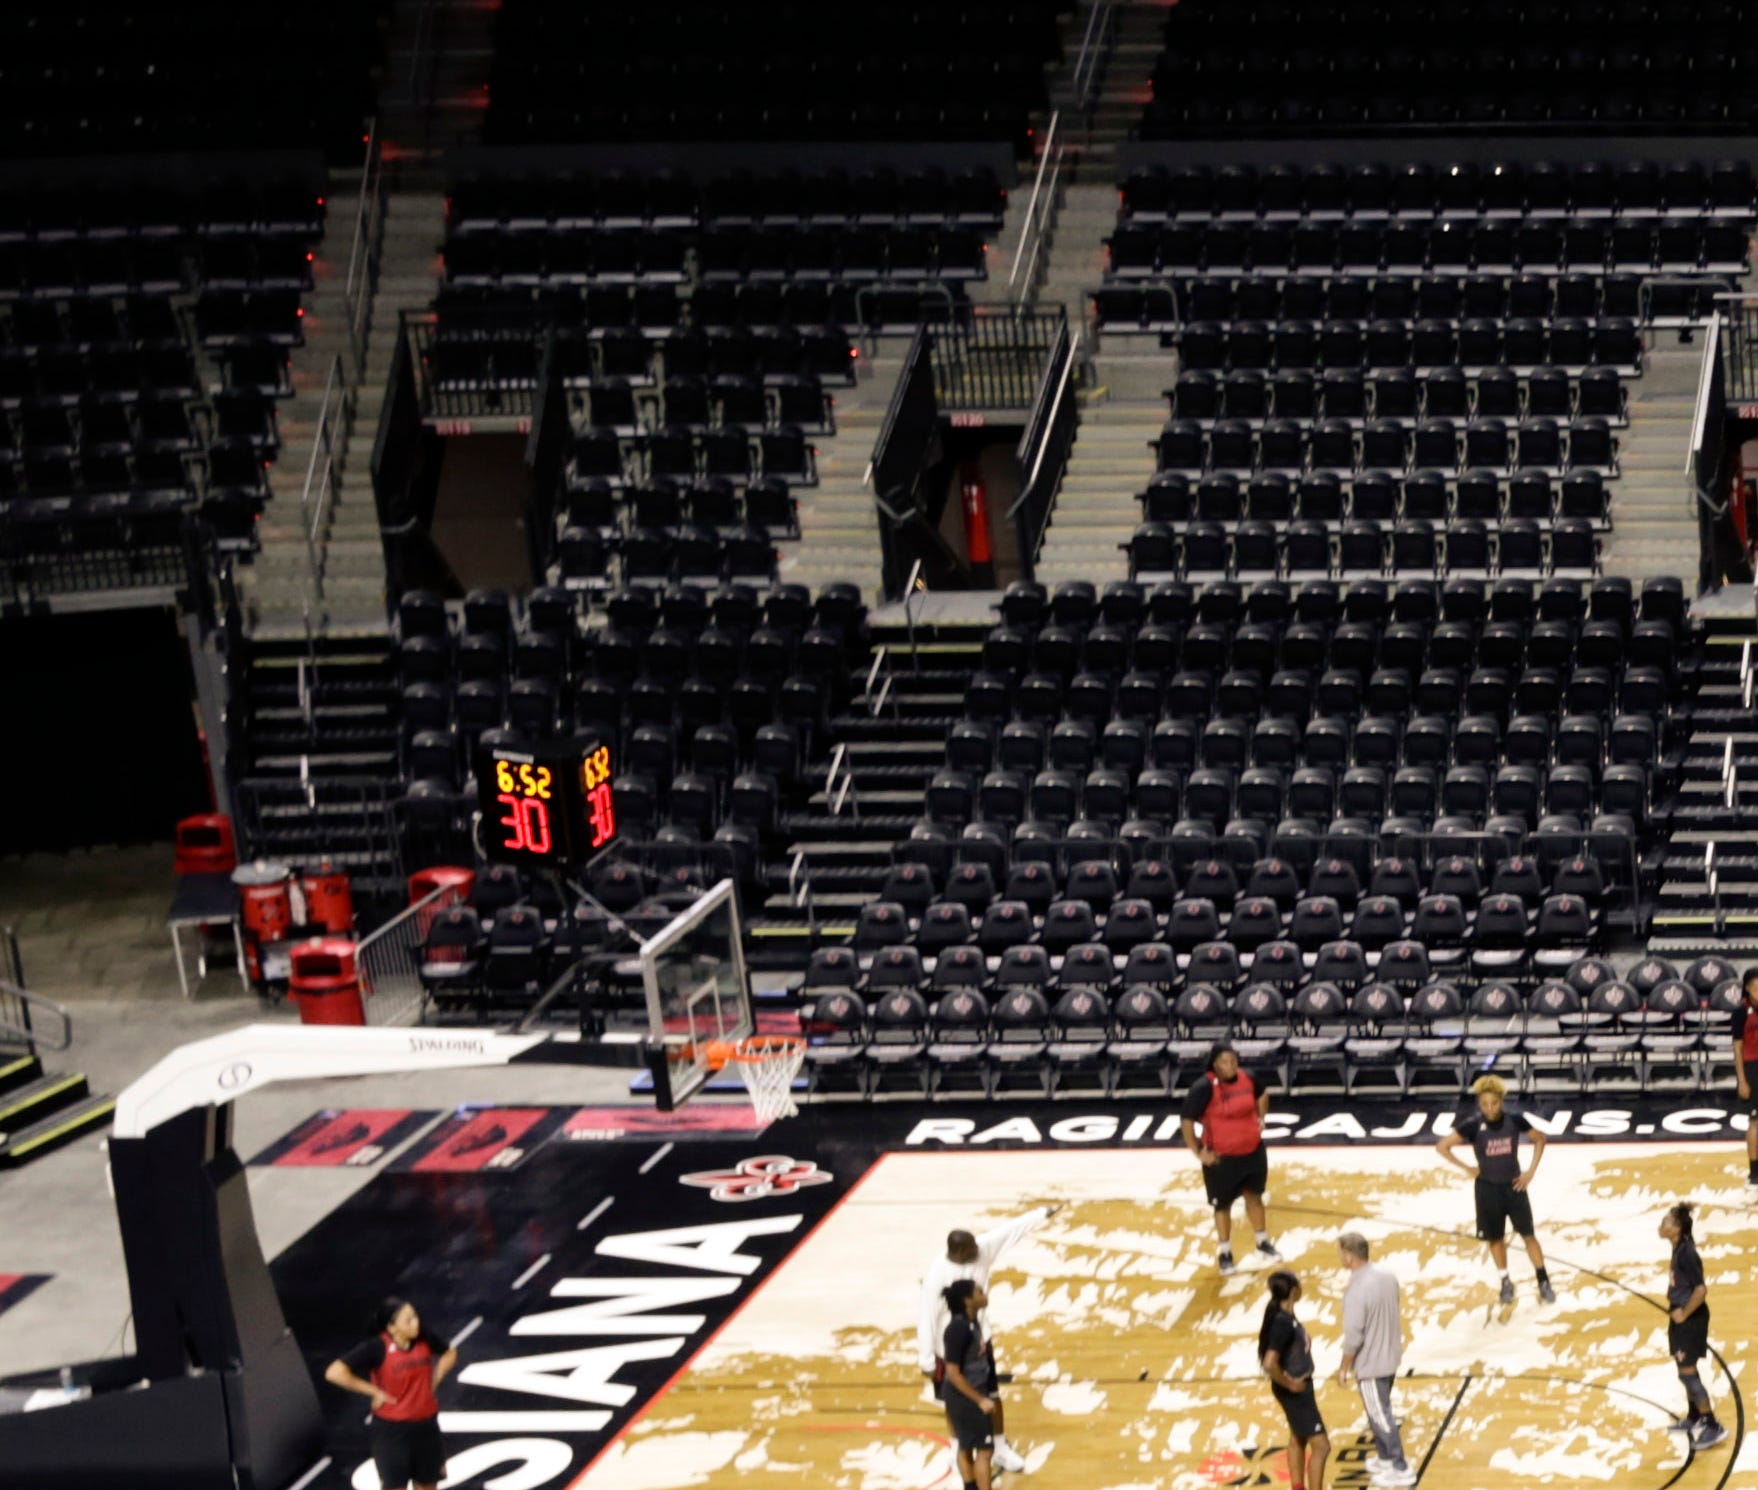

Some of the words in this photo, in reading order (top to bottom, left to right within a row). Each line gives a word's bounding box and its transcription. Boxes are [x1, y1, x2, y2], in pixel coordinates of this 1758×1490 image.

[496, 760, 551, 799] 6:52
[498, 794, 551, 854] 30
[587, 783, 614, 847] 30
[409, 1037, 484, 1054] SPALDING
